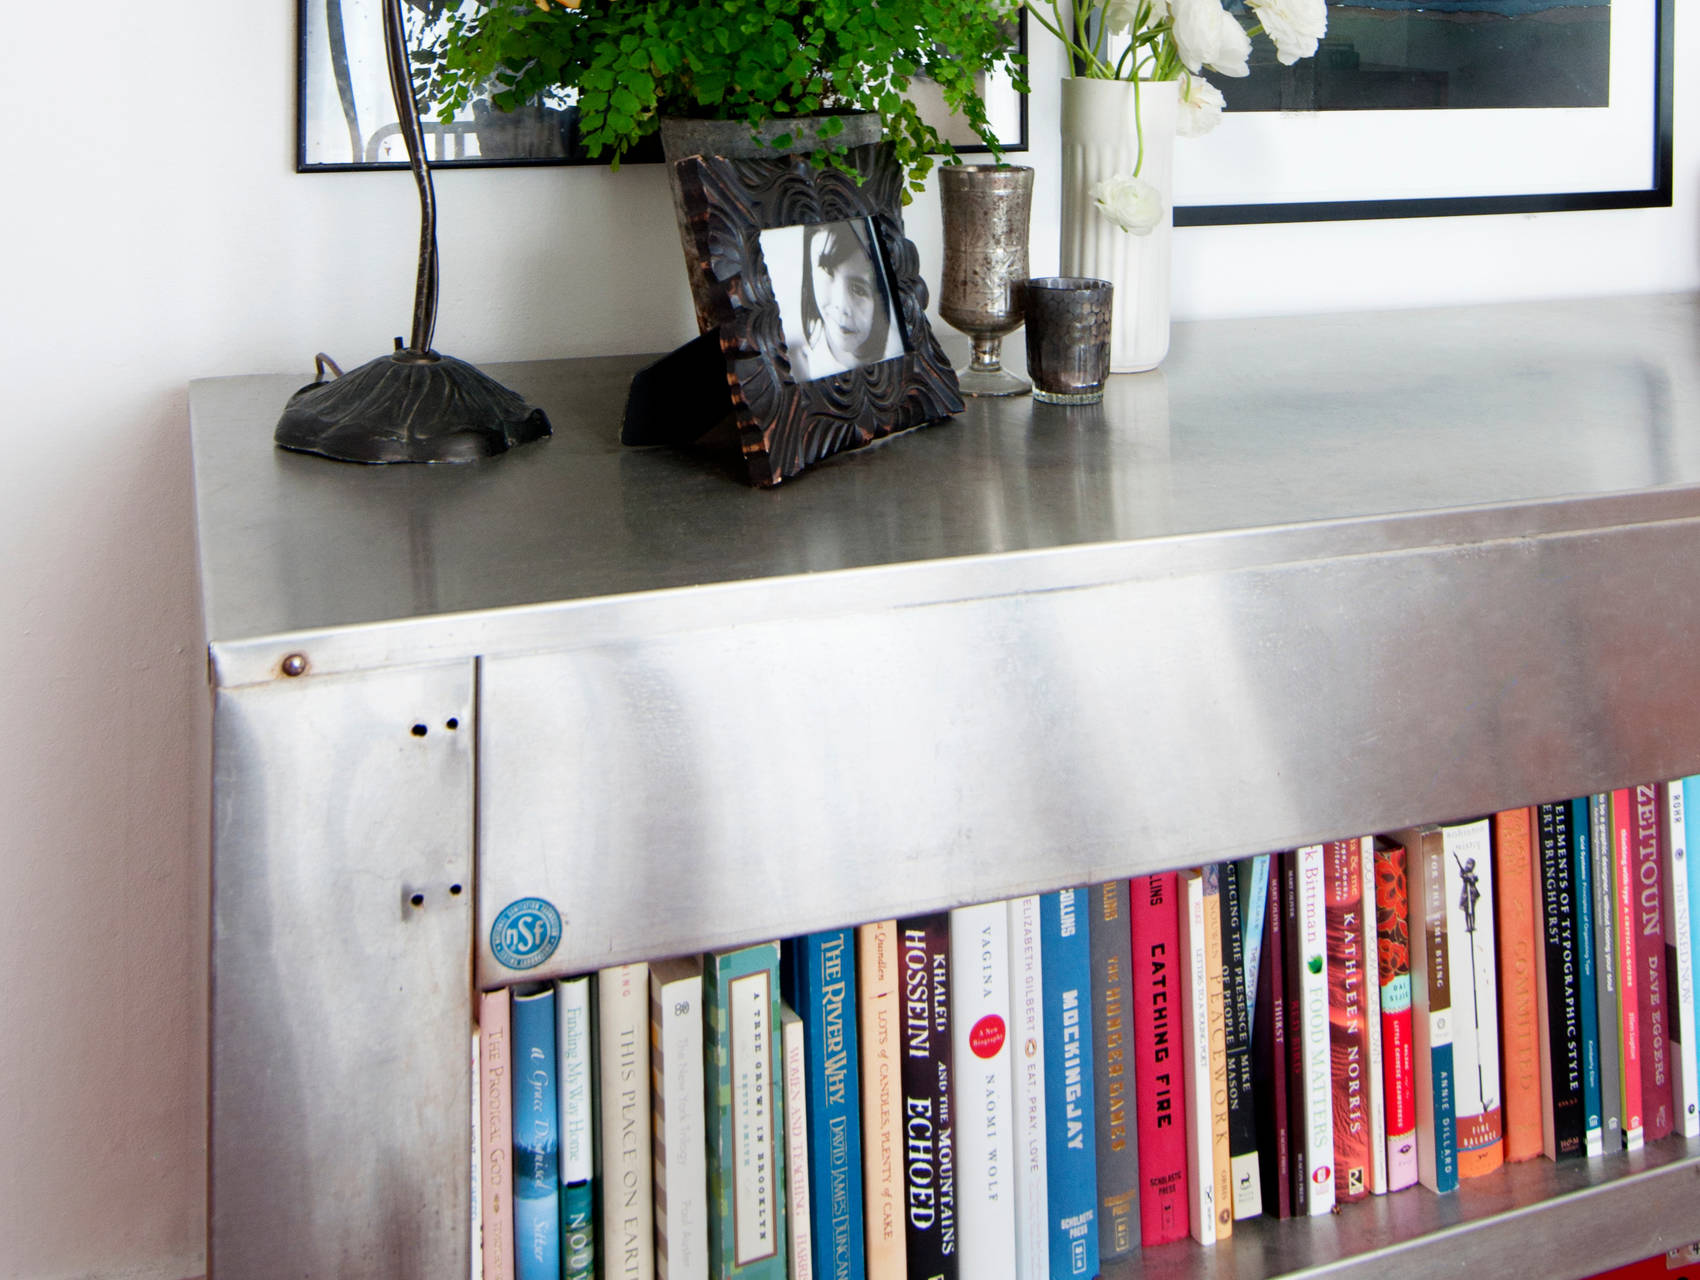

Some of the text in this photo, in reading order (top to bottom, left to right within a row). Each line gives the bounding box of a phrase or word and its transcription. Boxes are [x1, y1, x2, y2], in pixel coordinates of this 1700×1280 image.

[1673, 794, 1682, 824] ROHR
[1555, 805, 1570, 889] ELEMENTS
[1579, 835, 1587, 850] Grid
[1599, 823, 1610, 854] graphic
[1636, 783, 1661, 936] ZEITOUN
[1351, 875, 1358, 896] me
[1430, 854, 1439, 879] FOR
[1622, 866, 1630, 885] with
[1271, 878, 1280, 933] MARY OLIVER
[1305, 867, 1319, 943] Bittman
[1432, 883, 1440, 906] THE
[1544, 839, 1560, 945] BRINGHURST
[1560, 892, 1570, 914] OF
[1602, 895, 1612, 926] without
[1210, 899, 1220, 959] NOUWEN
[1226, 861, 1248, 1042] CTICING THE PRESENCE
[1602, 927, 1613, 953] losing
[1624, 915, 1632, 957] CRITICAL
[981, 926, 993, 998] VAGINA
[1022, 898, 1036, 1032] ELIZABETH GILBERT
[1434, 949, 1444, 988] BEING
[1561, 918, 1577, 1037] TYPOGRAPHIC
[1604, 954, 1613, 972] your
[1606, 973, 1614, 991] soul
[904, 929, 930, 1058] HOSSEINI
[932, 953, 948, 1032] KHALED
[1222, 965, 1235, 1045] OF PEOPLE
[754, 1009, 763, 1053] TREE
[821, 933, 848, 1107] THE RIVER WHY
[877, 1010, 889, 1044] LOTS
[1151, 943, 1172, 1129] CATCHING FIRE
[1274, 997, 1285, 1043] THIRST
[1343, 912, 1362, 1134] KATHLEEN NORRIS
[1393, 1020, 1401, 1045] LITTLE
[1648, 954, 1666, 1087] DAVE EGGERS
[877, 1048, 890, 1060] of
[1027, 1063, 1037, 1093] EAT,
[1062, 989, 1084, 1149] MOCKINGJAY
[1105, 956, 1127, 1153] THE HUNGER GAMES
[1210, 974, 1228, 1145] PEACEWORK
[1240, 1054, 1251, 1092] MIKE
[1310, 987, 1328, 1149] FOOD MATTERS
[1567, 1041, 1580, 1091] STYLE
[489, 1025, 506, 1186] THE PRODIGAL GOD
[528, 1070, 549, 1113] Grace
[565, 1006, 585, 1161] Finding My Way Home
[755, 1061, 764, 1117] GROWS
[1227, 1057, 1239, 1110] MASON
[757, 1126, 765, 1142] IN
[791, 1105, 803, 1137] AND
[829, 1115, 848, 1166] DAVID
[985, 1074, 1000, 1202] NAOMI WOLF
[1028, 1096, 1039, 1135] PRAY,
[1439, 1071, 1452, 1174] ANNIE DILLARD
[1463, 1130, 1498, 1148] BALANCE
[1472, 1123, 1490, 1135] FINE
[620, 1025, 641, 1280] THIS PLACE ON EART
[880, 1131, 893, 1183] PLENTY
[906, 1096, 936, 1231] ECHOED
[937, 1060, 955, 1256] AND THE MOUNTAINS
[1030, 1139, 1040, 1174] LOVE
[758, 1153, 767, 1240] BROOKLYN
[831, 1166, 849, 1216] JAMES
[880, 1187, 893, 1200] of
[1149, 1171, 1182, 1187] SCHOLASTIC
[883, 1202, 894, 1241] CAKE
